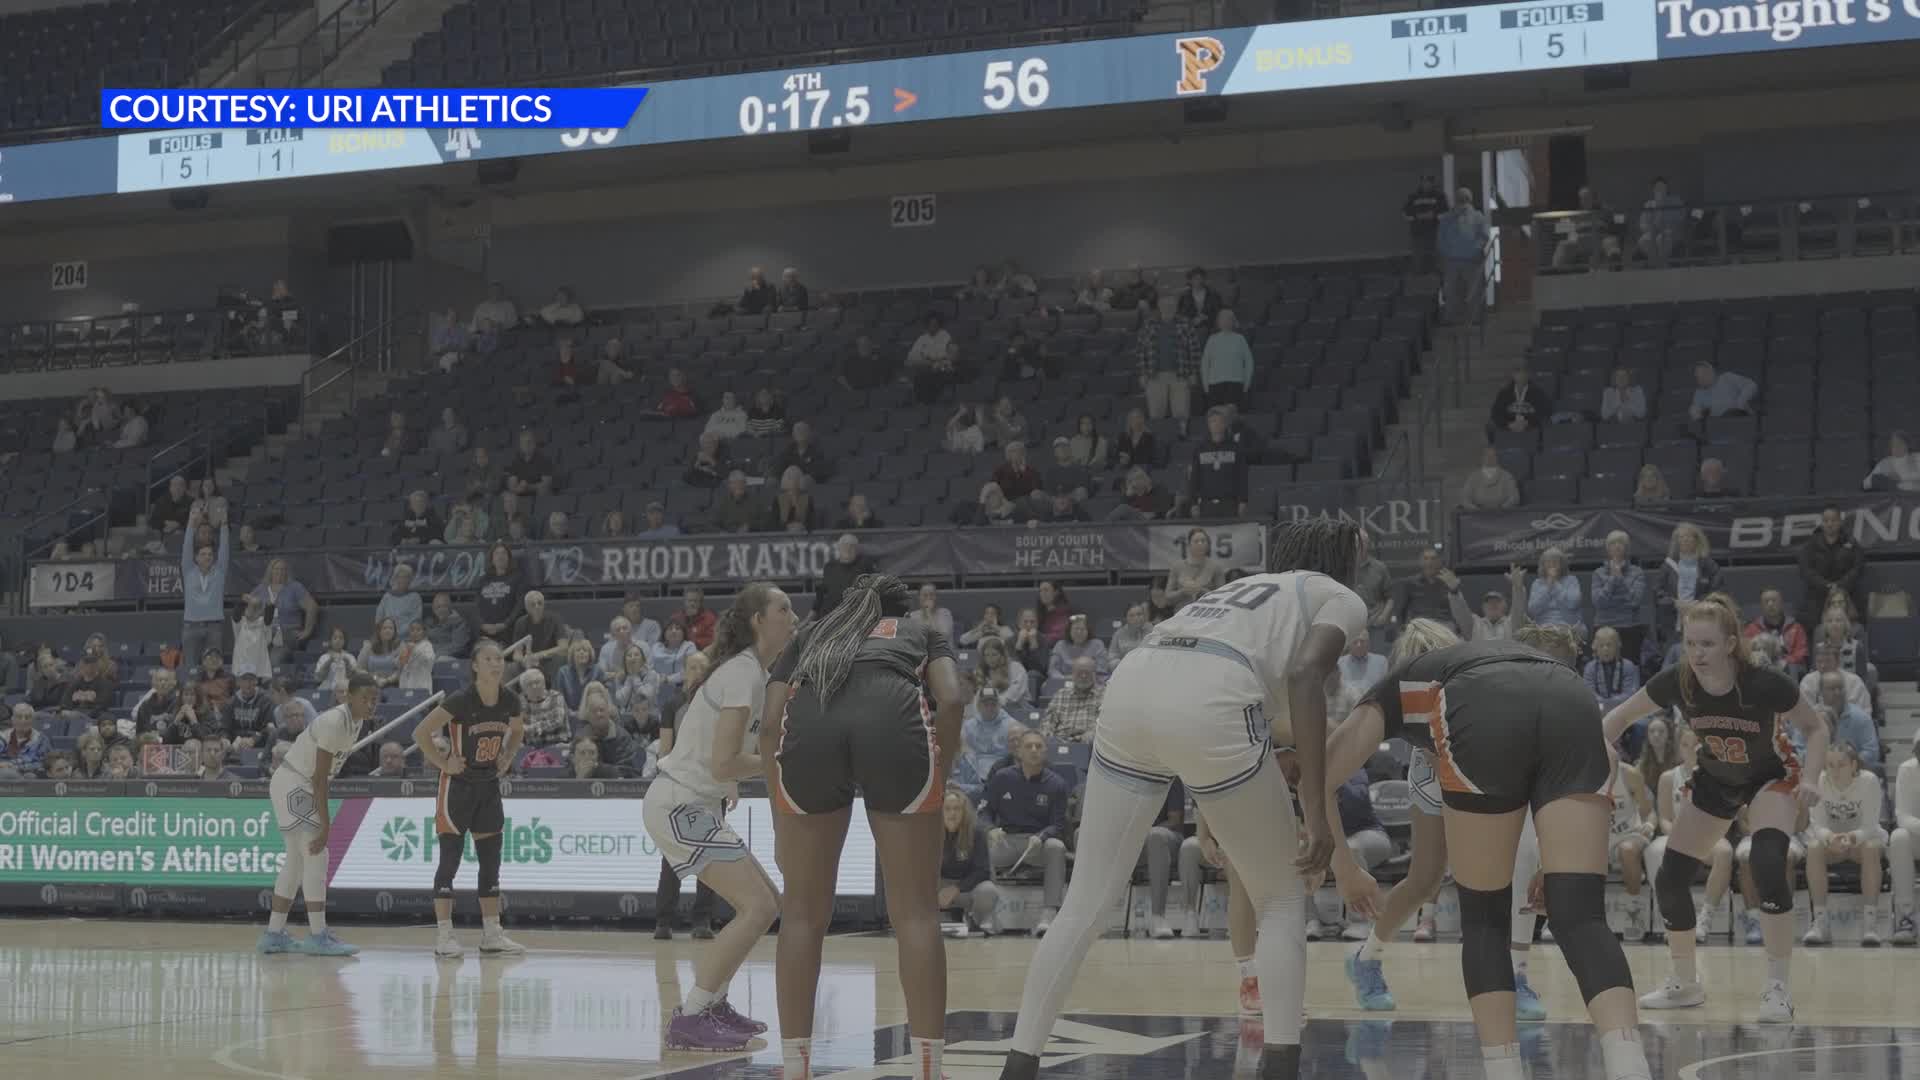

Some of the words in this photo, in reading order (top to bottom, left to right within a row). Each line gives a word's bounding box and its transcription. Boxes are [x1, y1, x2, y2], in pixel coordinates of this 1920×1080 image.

[1405, 16, 1463, 37] T.O.L.
[1515, 4, 1590, 27] FOULS
[1255, 42, 1353, 72] BONUS
[1423, 43, 1440, 69] 3
[1545, 32, 1566, 59] 5
[783, 71, 823, 91] 4TH
[981, 58, 1050, 111] 56
[738, 85, 871, 135] 0:17.5
[160, 134, 212, 153] FOULS
[329, 128, 406, 155] BONUS
[179, 155, 193, 179] 5
[272, 149, 282, 172] 1
[892, 199, 936, 223] 205
[54, 264, 85, 287] 204
[1015, 535, 1054, 548] SOUTH
[1057, 533, 1104, 546] COUNTY
[1173, 533, 1234, 561] 15
[601, 545, 715, 581] RHODY
[727, 540, 840, 578] NATIO
[1015, 548, 1105, 568] HEALTH
[148, 577, 184, 593] HEA
[0, 809, 78, 838] Official
[84, 809, 158, 838] Credit
[163, 809, 237, 838] Union
[242, 808, 273, 838] of
[557, 833, 639, 856] CREDIT
[31, 844, 155, 872] Women's
